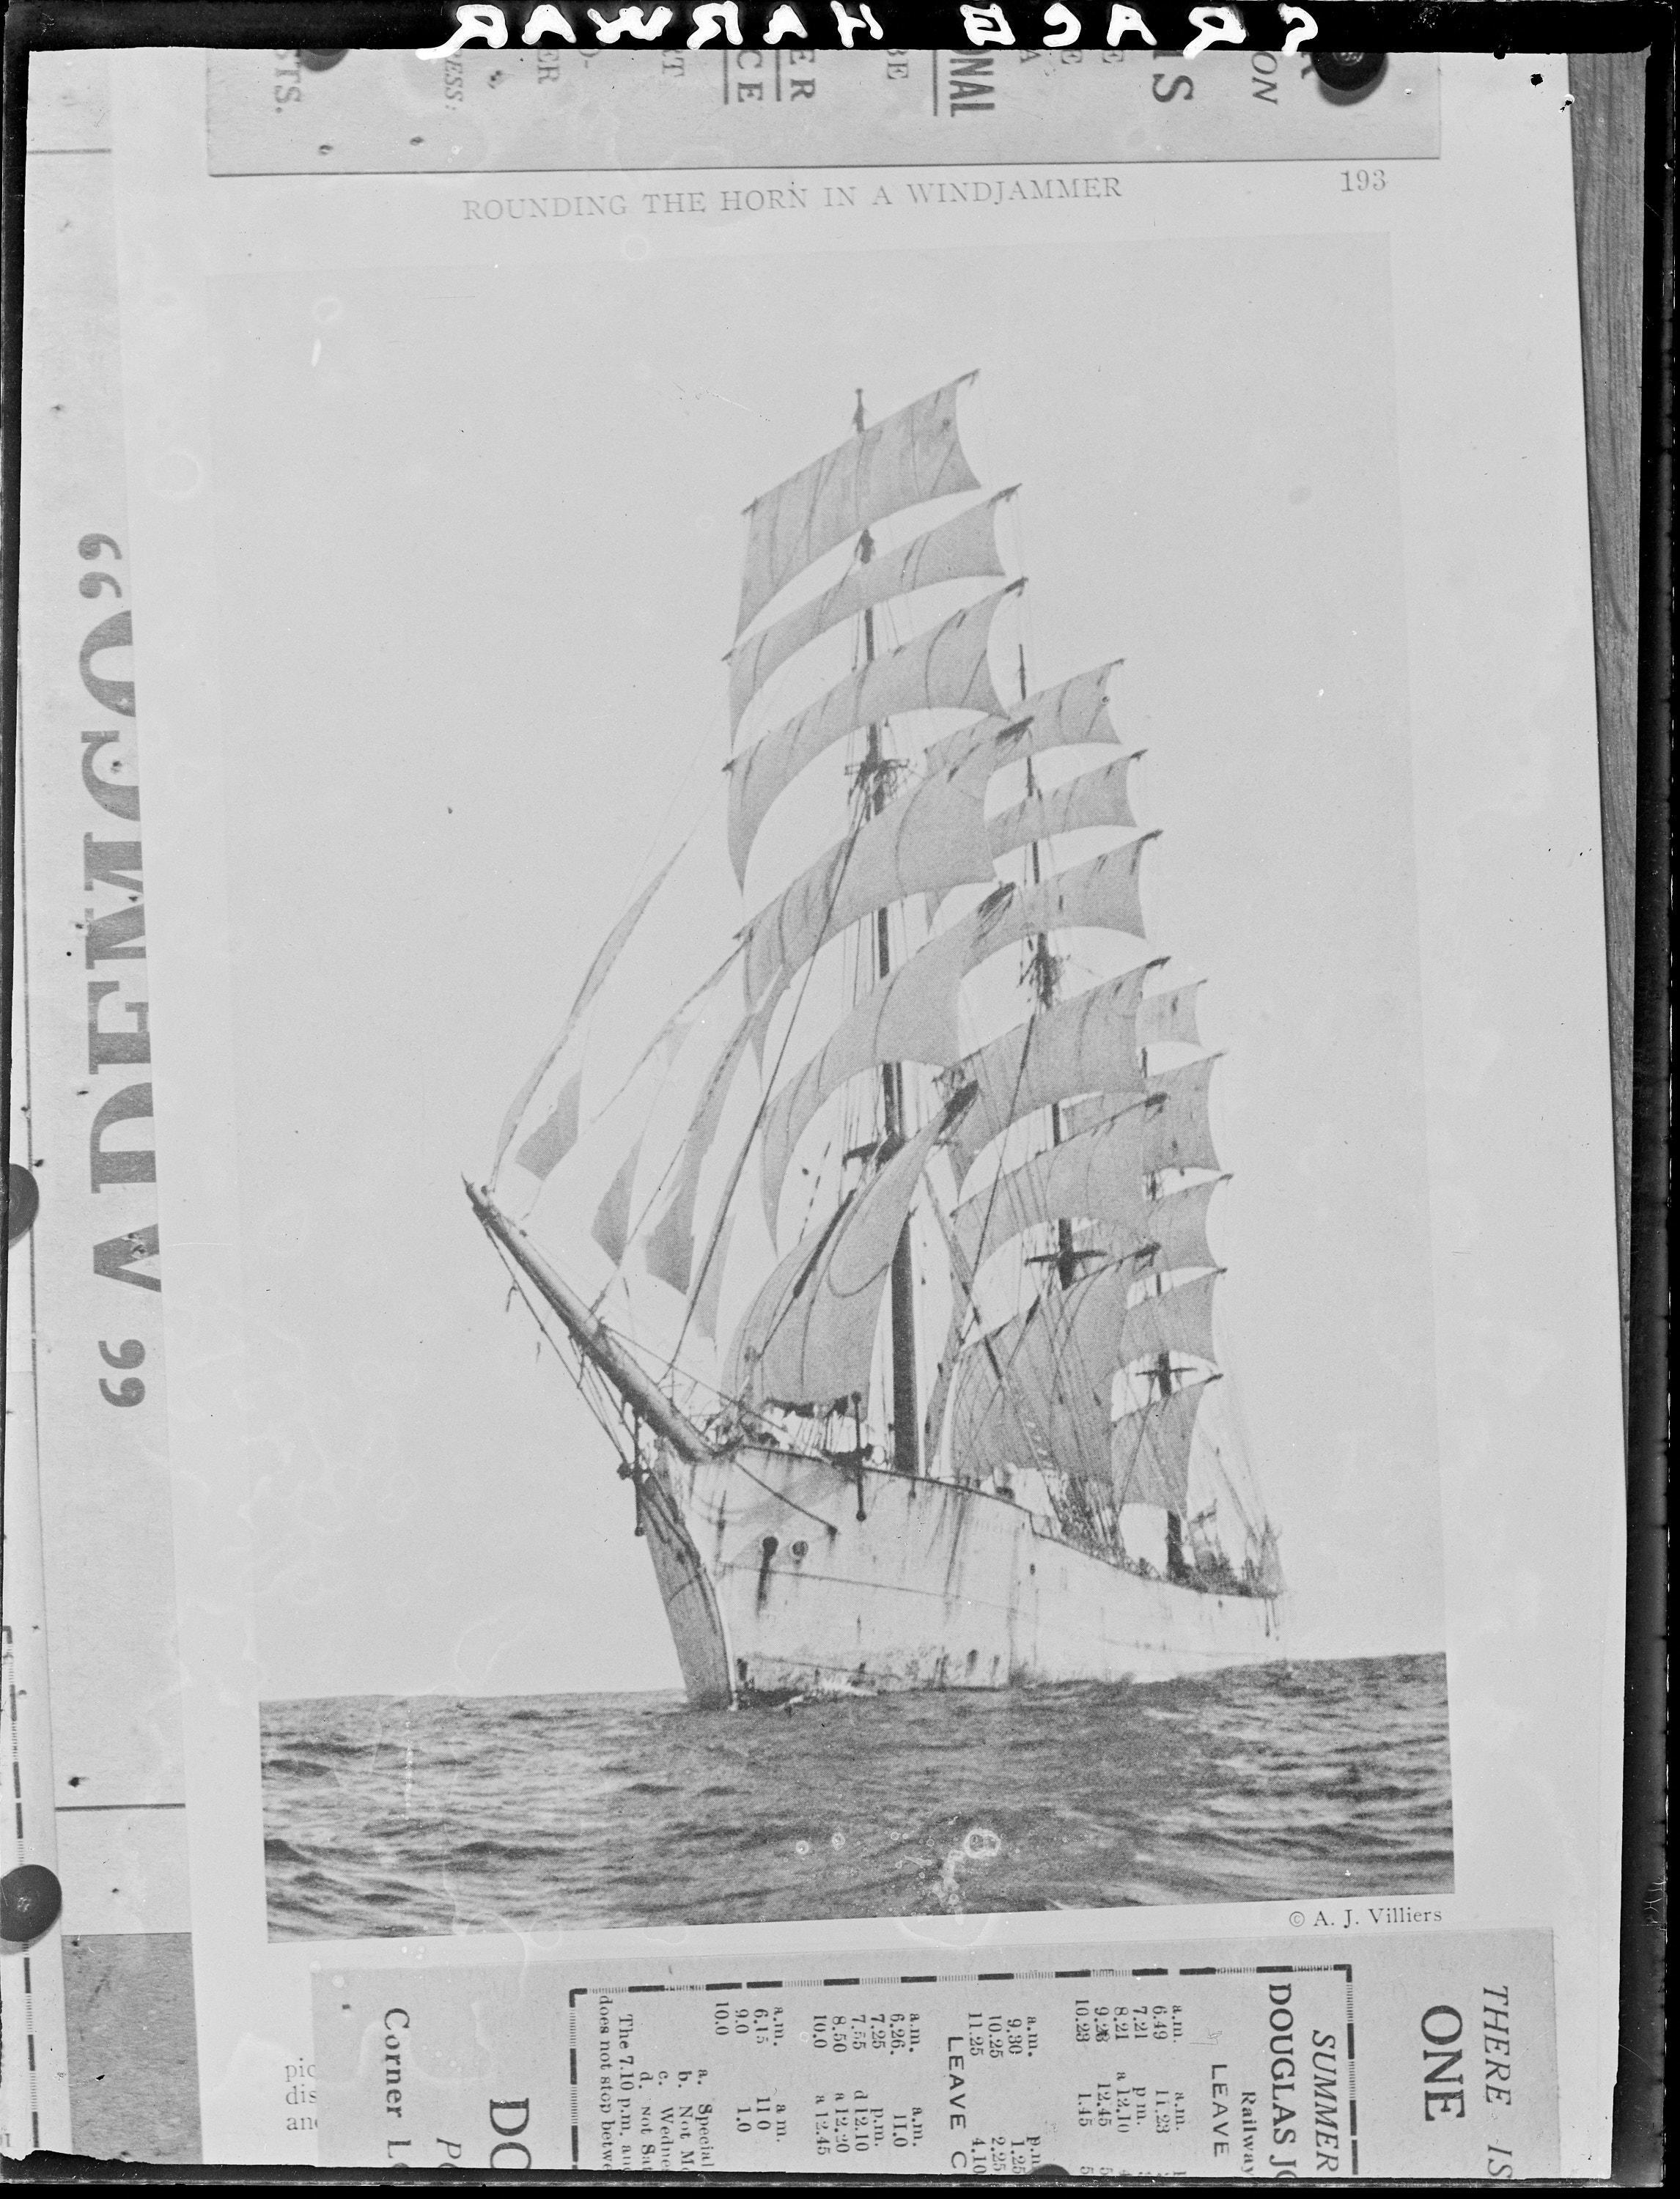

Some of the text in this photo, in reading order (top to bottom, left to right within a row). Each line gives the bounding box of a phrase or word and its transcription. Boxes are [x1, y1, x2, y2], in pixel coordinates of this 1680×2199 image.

[950, 50, 995, 117] NAL
[463, 177, 1121, 220] ROUNDING THE HORN IN A WINDJAMMER
[1341, 169, 1388, 192] 193
[1314, 1910, 1334, 1926] A.
[1344, 1909, 1358, 1929] J.
[1368, 1907, 1442, 1923] Villiers
[600, 1995, 613, 2034] does
[619, 2014, 633, 2049] The
[715, 2002, 729, 2036] 10.0
[734, 2008, 749, 2034] 9.0
[773, 2006, 785, 2047] a.m.
[812, 2015, 828, 2049] 10.0
[870, 2014, 886, 2049] 7.25
[909, 2013, 922, 2052] a.m.
[968, 2012, 984, 2056] 11.25
[1113, 2006, 1129, 2040] 8.21
[1133, 2005, 1149, 2038] 7.21
[1152, 2005, 1168, 2040] 6.49
[1173, 2005, 1185, 2044] a.m.
[832, 2016, 847, 2053] 8.50
[988, 2015, 1003, 2058] 10.25
[1006, 2019, 1023, 2055] 9.30
[1027, 2016, 1039, 2058] a.m.
[1483, 1986, 1511, 2106] THERE
[385, 2008, 410, 2118] Corner
[600, 2041, 614, 2070] not
[620, 2055, 634, 2091] 7.10
[1269, 1983, 1297, 2145] DOUGLAS
[1421, 2005, 1465, 2121] ONE
[600, 2076, 615, 2113] stop
[638, 2071, 652, 2089] d.
[677, 2071, 692, 2088] b.
[947, 2036, 966, 2130] LEAVE
[616, 2098, 631, 2137] p.m.
[737, 2107, 752, 2132] 1.0
[1077, 2093, 1094, 2126] 1.45
[1097, 2082, 1112, 2126] 12.45
[1154, 2090, 1170, 2134] 11.23
[1174, 2092, 1187, 2131] a.m.
[1211, 2064, 1229, 2158] LEAVE
[1311, 2030, 1340, 2173] SUMMER
[286, 2115, 318, 2131] an
[695, 2104, 714, 2167] Special
[854, 2108, 869, 2151] 12.10
[871, 2108, 885, 2147] p.m.
[911, 2107, 924, 2147] a.m.
[1240, 2091, 1257, 2176] Railway
